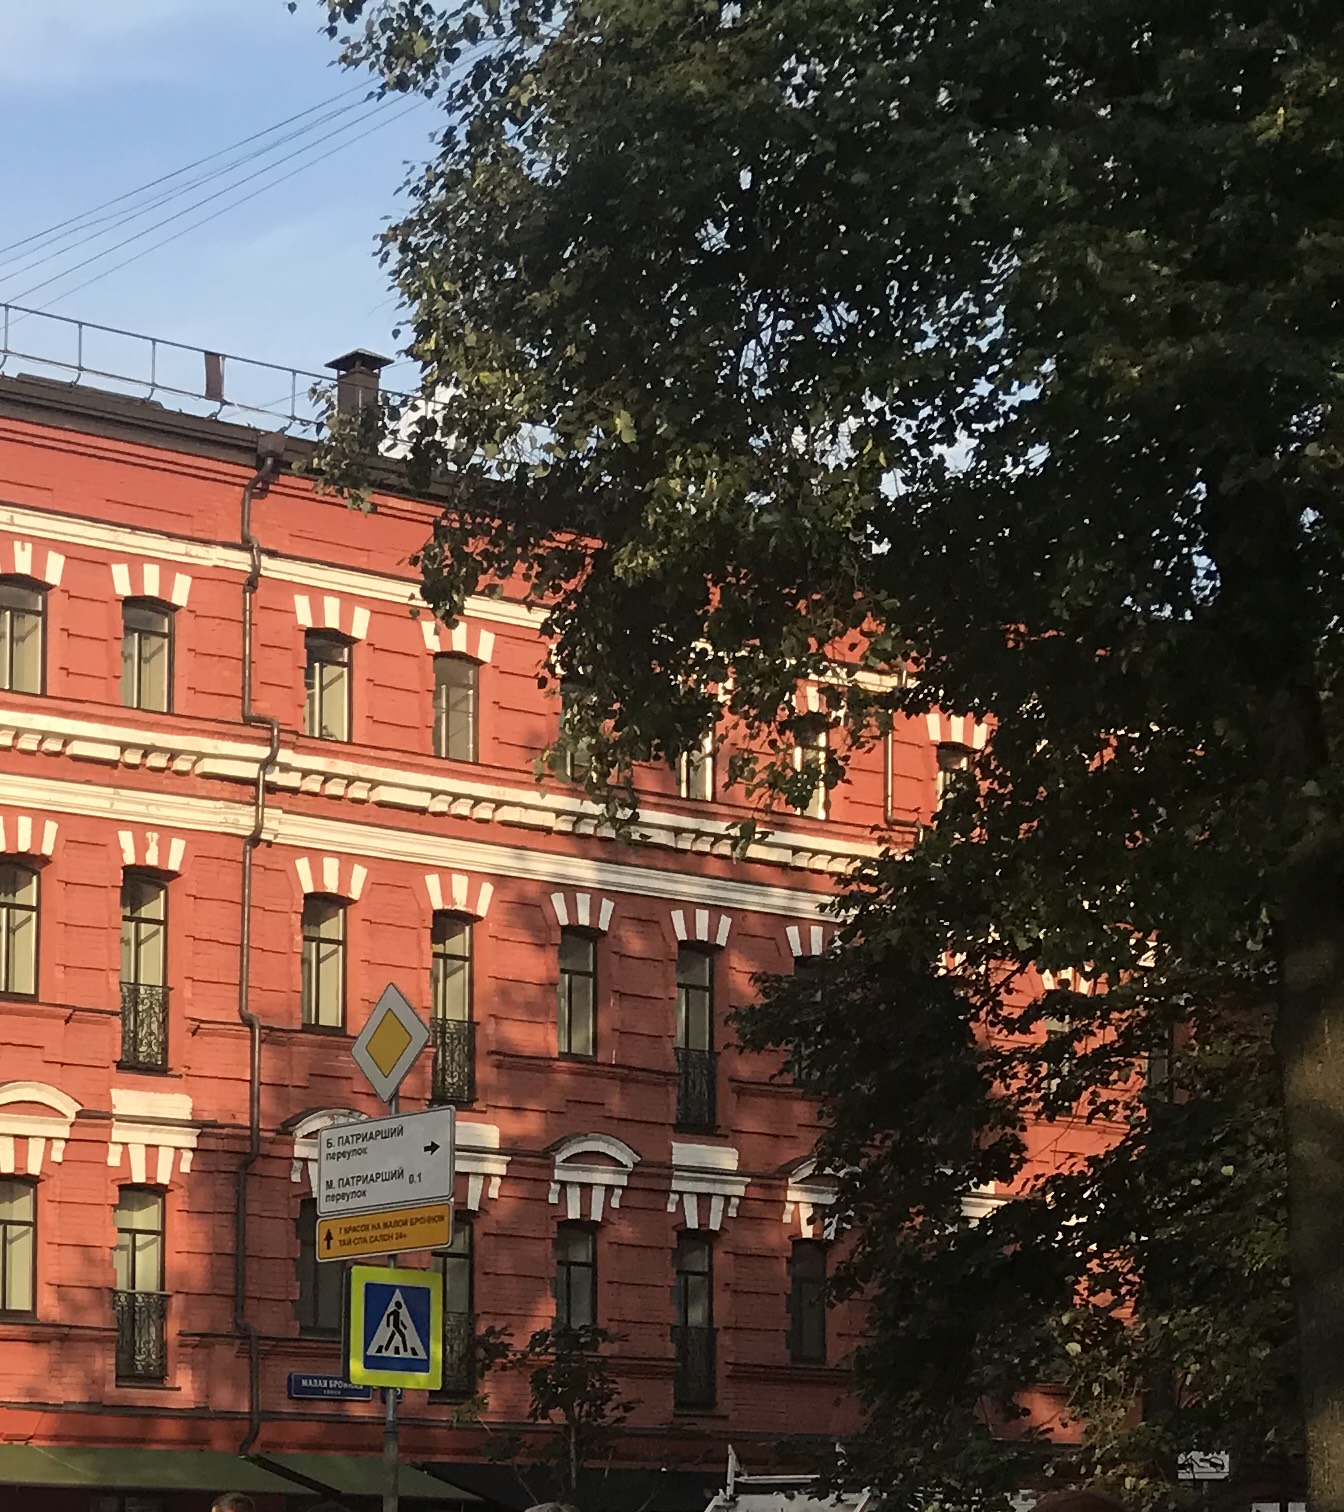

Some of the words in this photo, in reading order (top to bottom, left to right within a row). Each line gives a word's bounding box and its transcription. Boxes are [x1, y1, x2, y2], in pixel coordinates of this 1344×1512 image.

[337, 1124, 404, 1146] ПАТРИАРШИЙ
[325, 1147, 368, 1161] переулок
[337, 1167, 404, 1188] ПАТРИАРШИЙ
[408, 1172, 422, 1185] 0.1
[325, 1189, 367, 1204] переулок
[301, 1379, 328, 1388] МАЛАЯ
